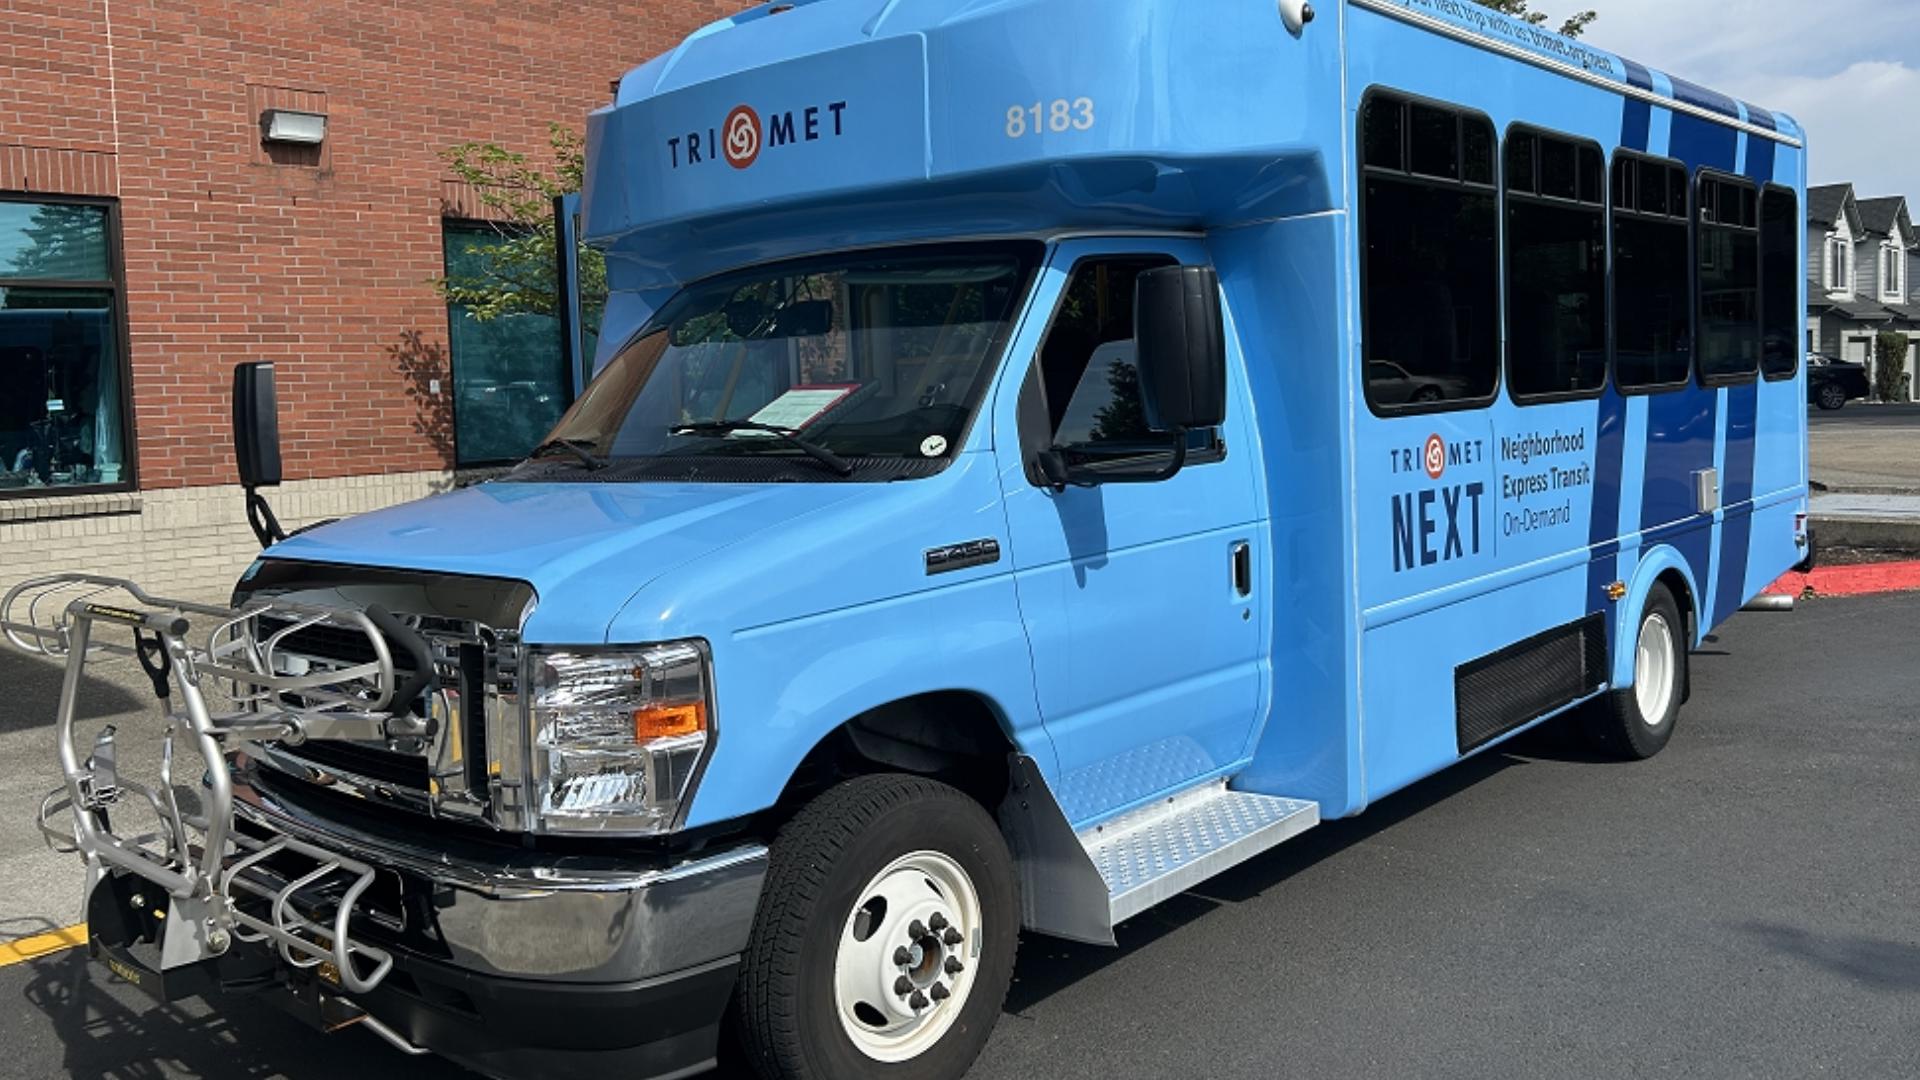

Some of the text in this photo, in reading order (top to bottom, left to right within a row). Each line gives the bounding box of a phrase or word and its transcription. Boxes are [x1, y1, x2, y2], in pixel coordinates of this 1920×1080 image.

[1005, 96, 1095, 139] 8183
[1501, 428, 1584, 465] Neighborhood
[1502, 462, 1590, 502] Express Transit
[1391, 481, 1484, 573] NEXT
[1502, 498, 1570, 537] On-Demand
